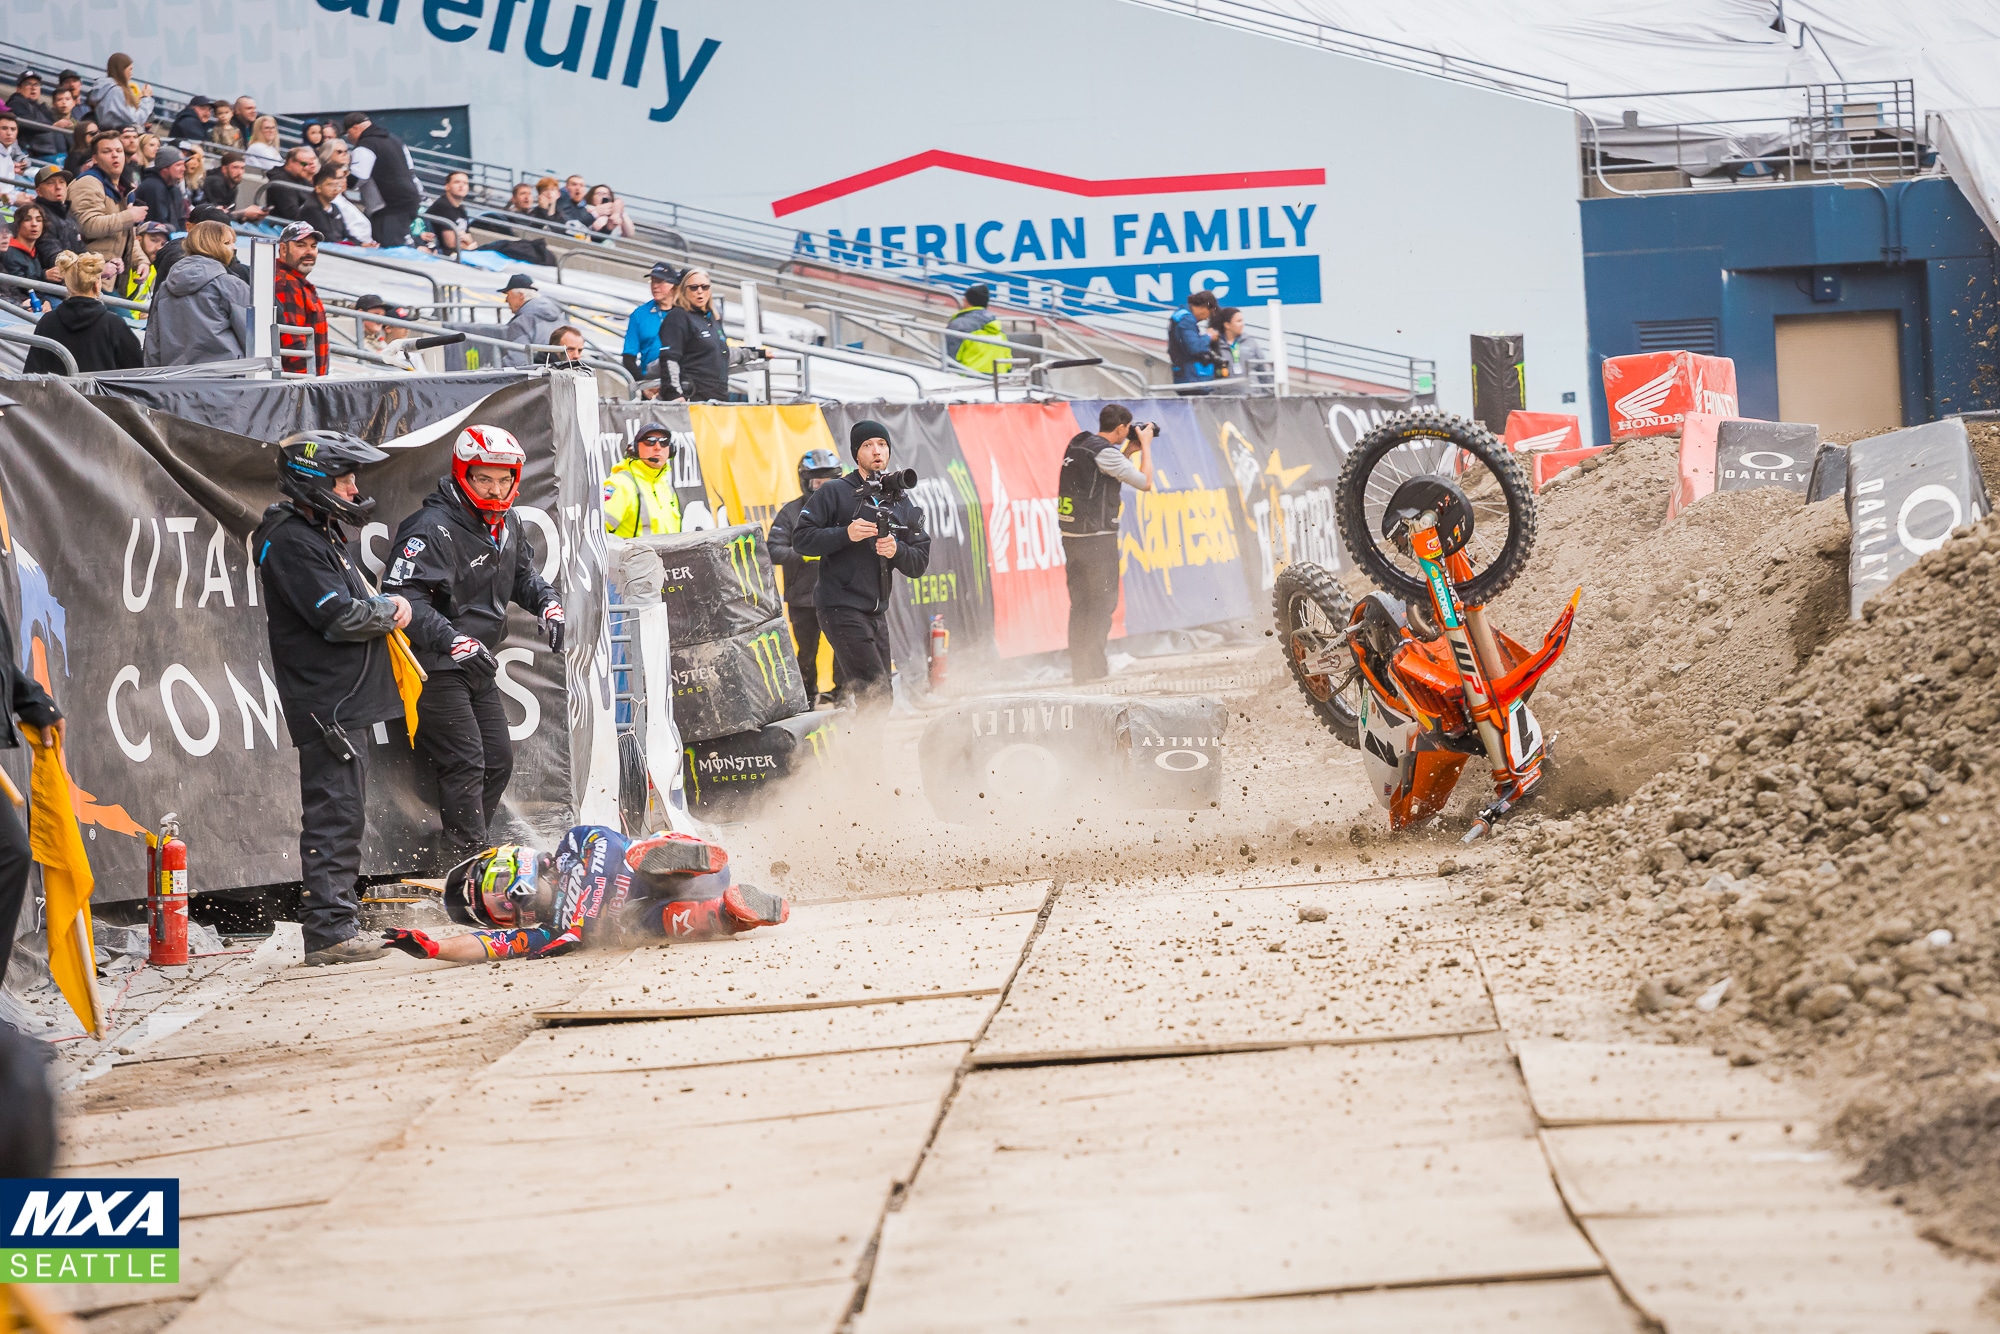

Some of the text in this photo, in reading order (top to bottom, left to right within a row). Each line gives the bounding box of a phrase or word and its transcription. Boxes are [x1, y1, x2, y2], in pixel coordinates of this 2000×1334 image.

[793, 204, 1317, 268] AMERICAN FAMILY
[991, 267, 1279, 310] RANCE
[1617, 412, 1684, 432] HONDA
[1725, 469, 1807, 482] OAKLEY
[1011, 497, 1067, 571] HON
[1857, 477, 1889, 582] OAKLEY
[1434, 578, 1452, 621] MOTOREX
[671, 665, 720, 686] NSTER
[1451, 638, 1485, 695] WP
[1142, 736, 1219, 748] OAKLEY
[1516, 704, 1534, 758] 1
[699, 752, 777, 773] MONSTER
[713, 772, 767, 782] ENERGY
